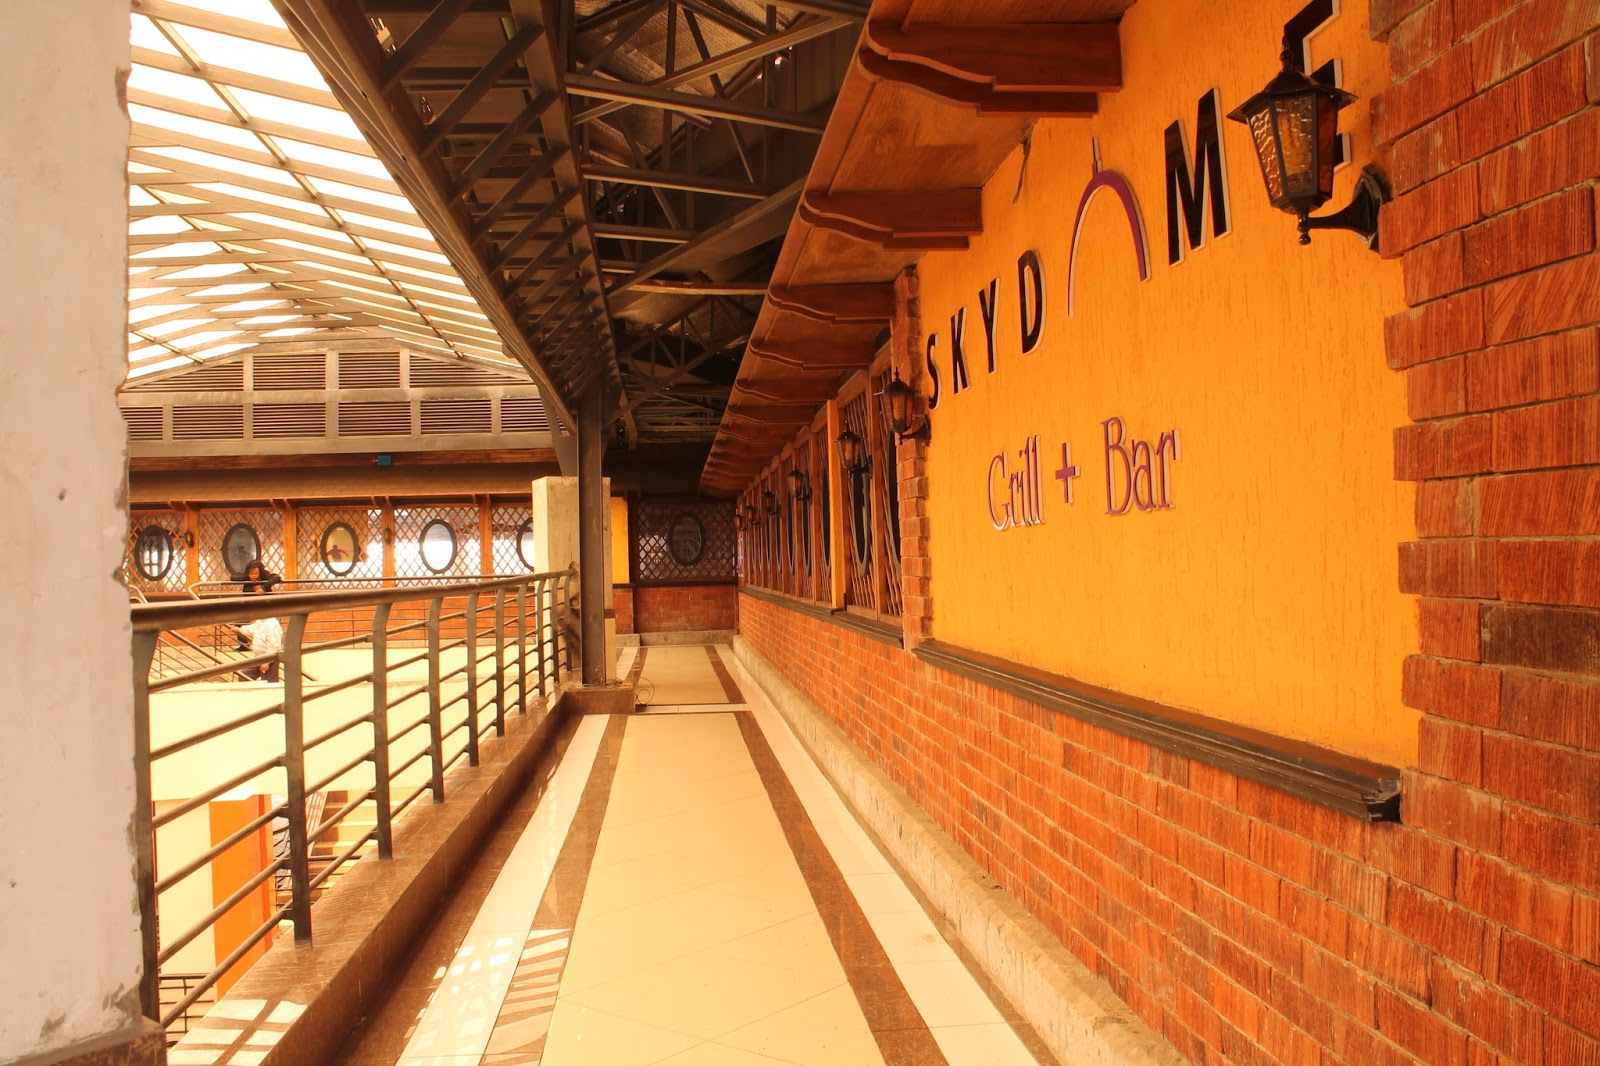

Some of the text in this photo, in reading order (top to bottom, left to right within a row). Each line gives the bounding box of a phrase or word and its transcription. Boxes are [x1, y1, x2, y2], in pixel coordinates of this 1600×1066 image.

[988, 416, 1181, 531] Grill + Bar
